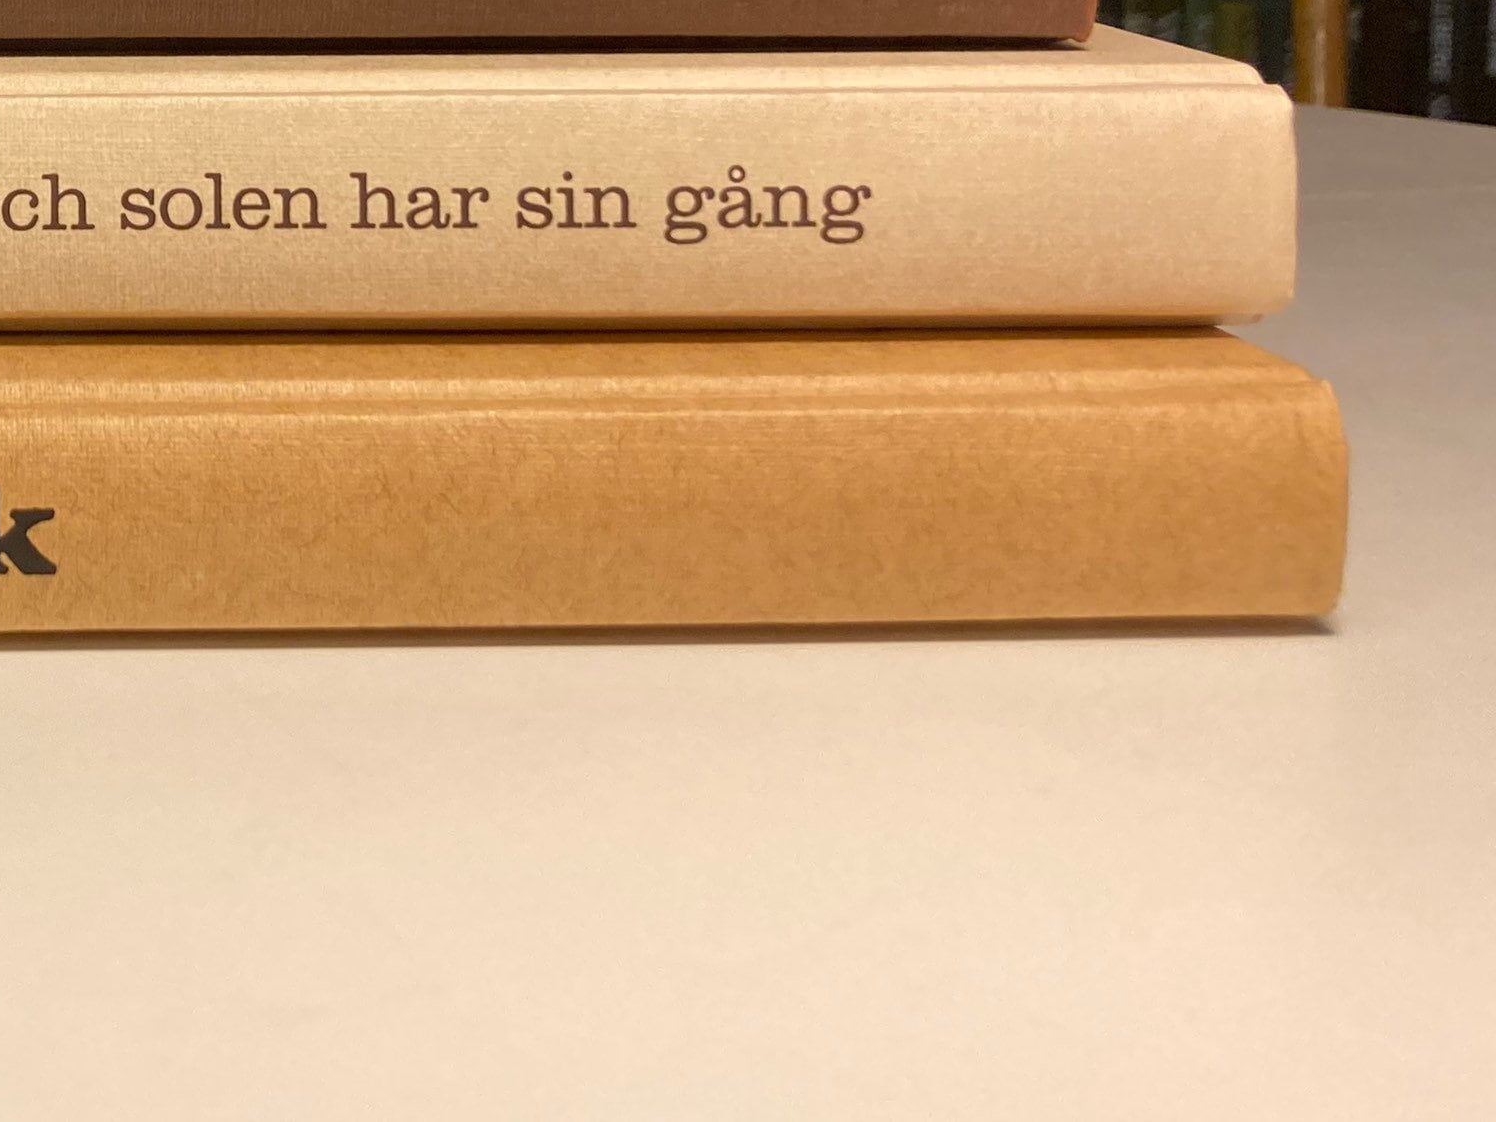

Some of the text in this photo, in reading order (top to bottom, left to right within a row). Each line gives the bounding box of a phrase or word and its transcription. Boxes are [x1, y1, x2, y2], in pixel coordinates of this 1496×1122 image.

[120, 173, 327, 231] solen
[351, 173, 490, 230] har
[516, 170, 637, 229] sin
[664, 165, 872, 244] gång
